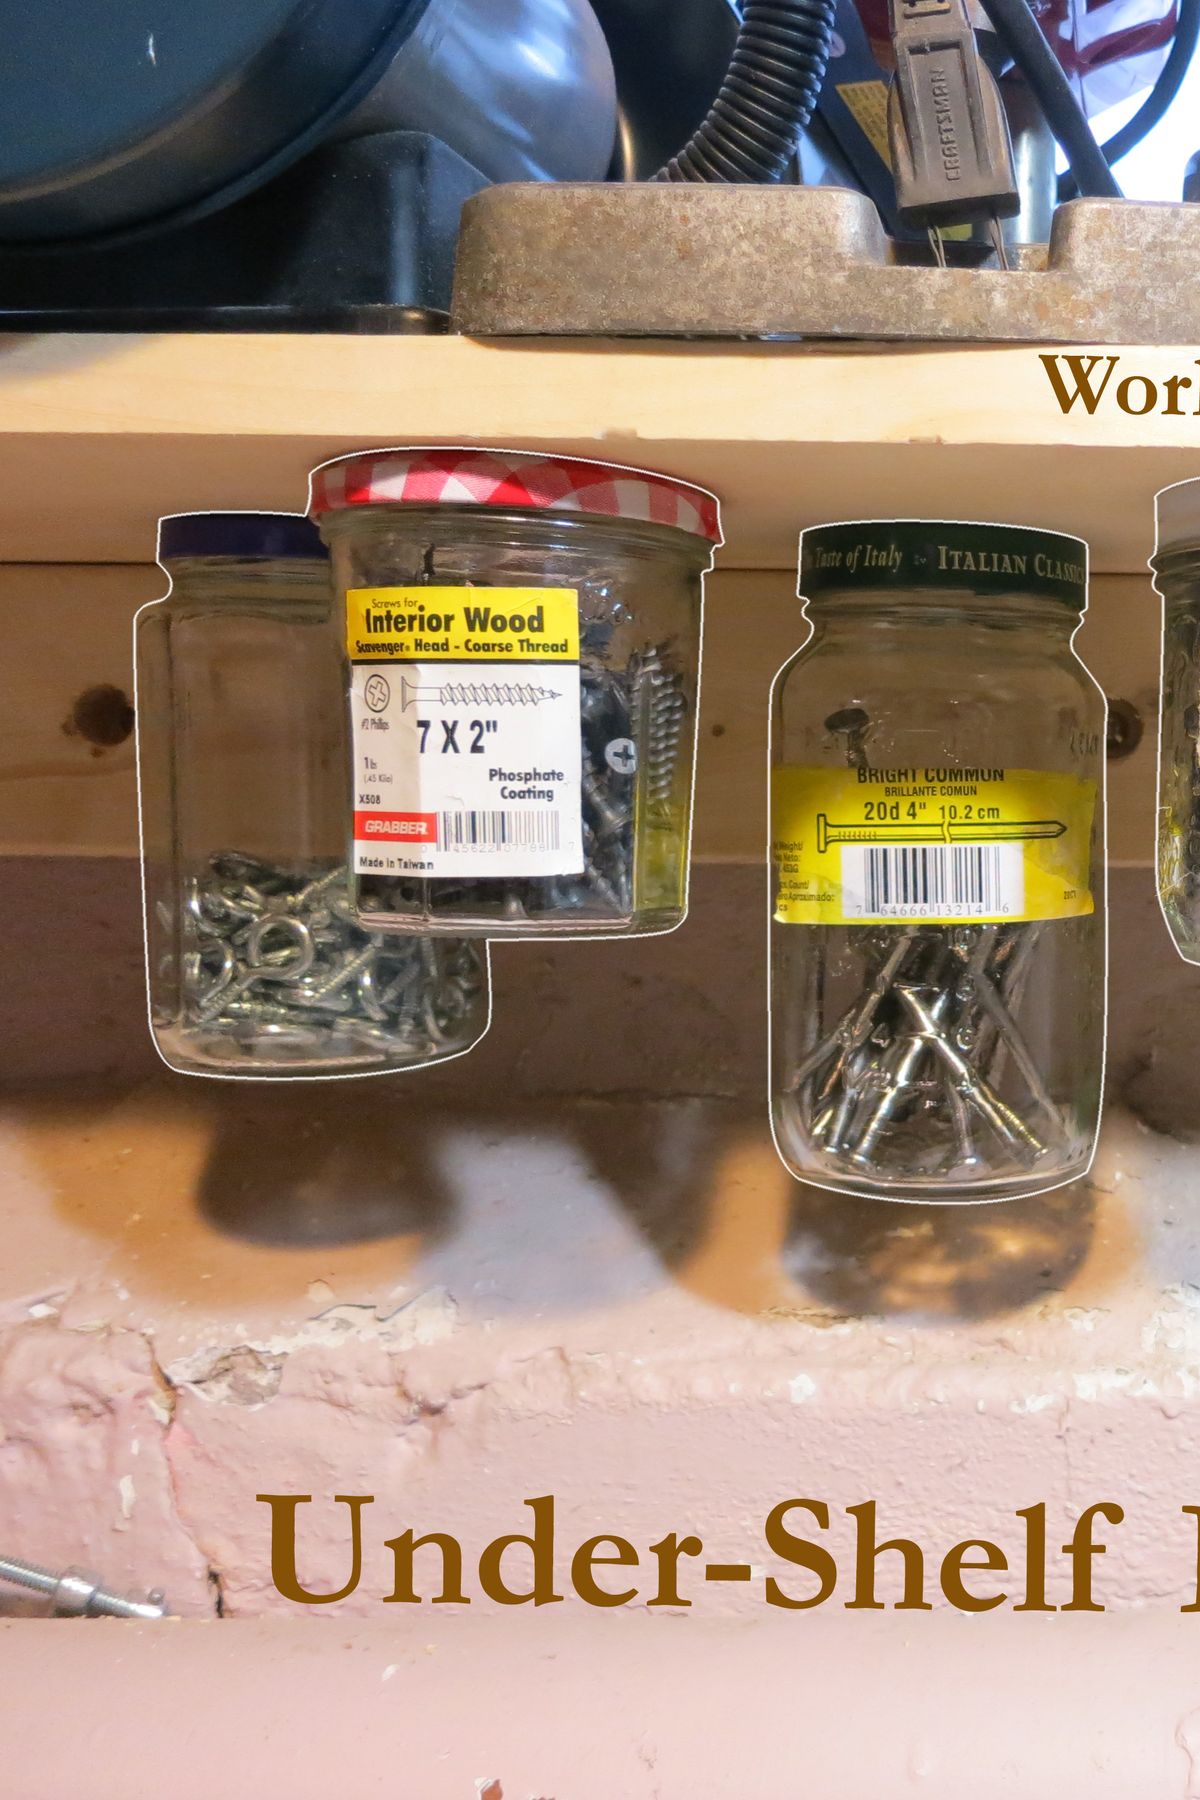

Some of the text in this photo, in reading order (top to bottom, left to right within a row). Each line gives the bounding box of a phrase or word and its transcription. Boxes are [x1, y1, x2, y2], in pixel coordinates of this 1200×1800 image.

[930, 68, 961, 182] CRAFTSMAN
[846, 545, 862, 573] of
[864, 544, 903, 573] Italy
[937, 545, 1027, 575] ITALIAN
[372, 597, 418, 609] Screws for
[365, 605, 545, 634] Interior Wood
[414, 639, 450, 653] Head
[464, 639, 513, 653] Coarse
[517, 639, 569, 654] Thread
[416, 719, 498, 754] 7 X 2"
[488, 768, 565, 785] Phosphate
[500, 786, 554, 802] Coating
[884, 785, 977, 797] BRILLANTE COMUN
[359, 795, 381, 805] X508
[864, 802, 900, 821] 20d
[939, 805, 973, 820] 10.2
[977, 808, 1000, 820] cm
[365, 821, 426, 835] GRABBER
[359, 857, 434, 871] Made in Taiwan
[880, 903, 927, 916] 64666
[936, 903, 983, 916] 13214
